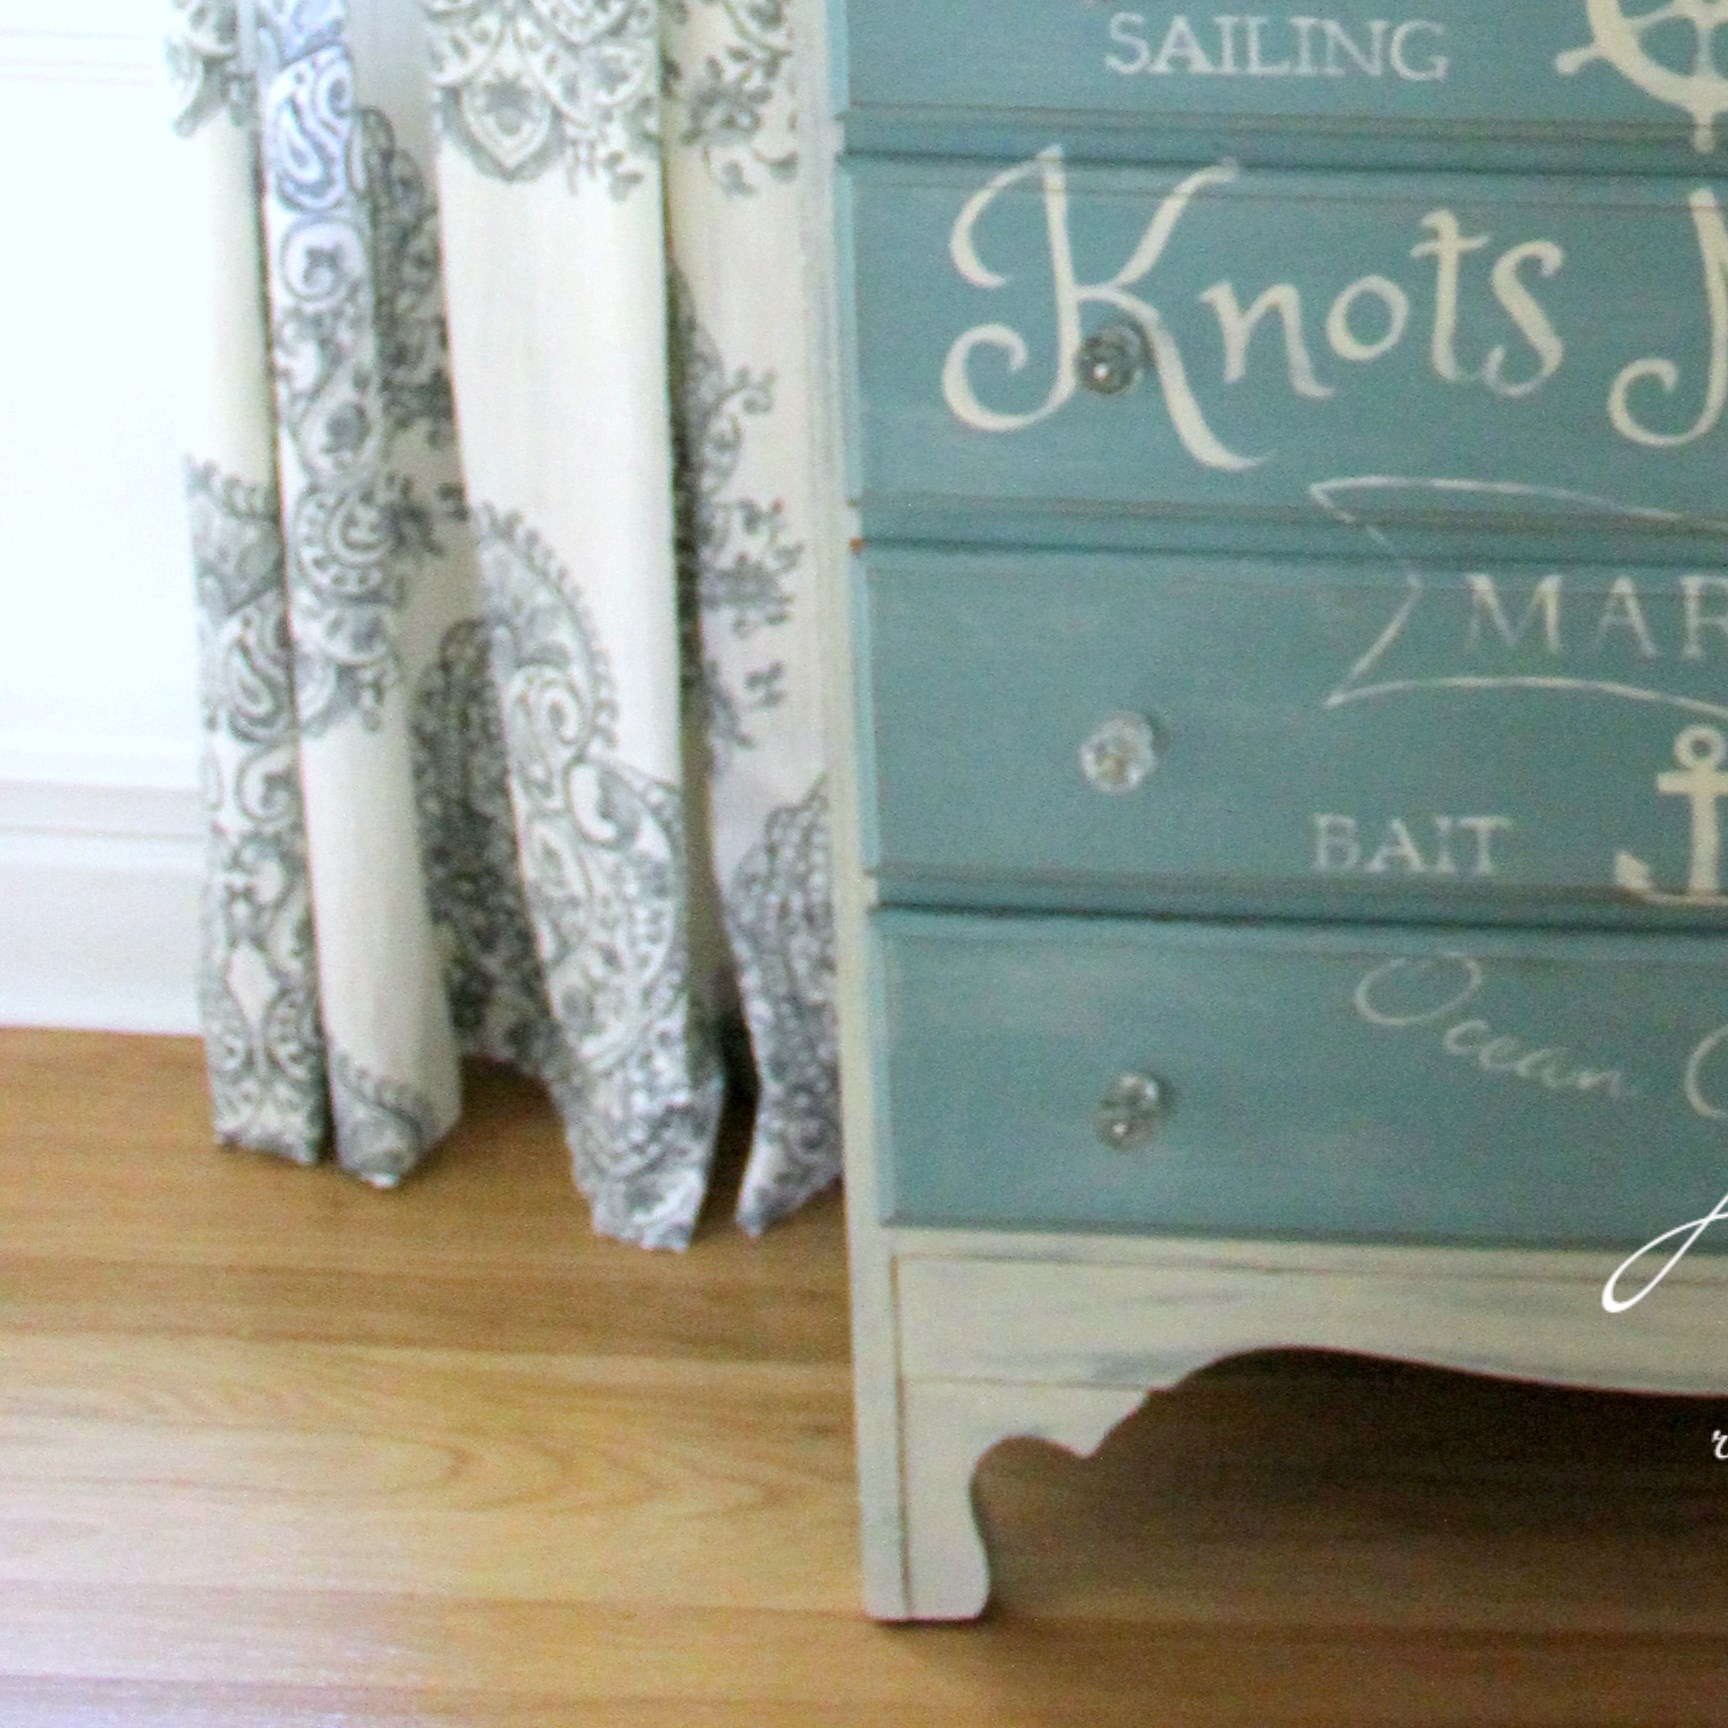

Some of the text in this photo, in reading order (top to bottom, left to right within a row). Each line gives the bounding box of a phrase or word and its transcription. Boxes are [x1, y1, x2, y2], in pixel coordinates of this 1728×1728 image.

[1104, 10, 1450, 87] SAILING
[941, 144, 1566, 472] Knots
[1310, 814, 1515, 879] BAIT
[1355, 951, 1637, 1099] Ocean
